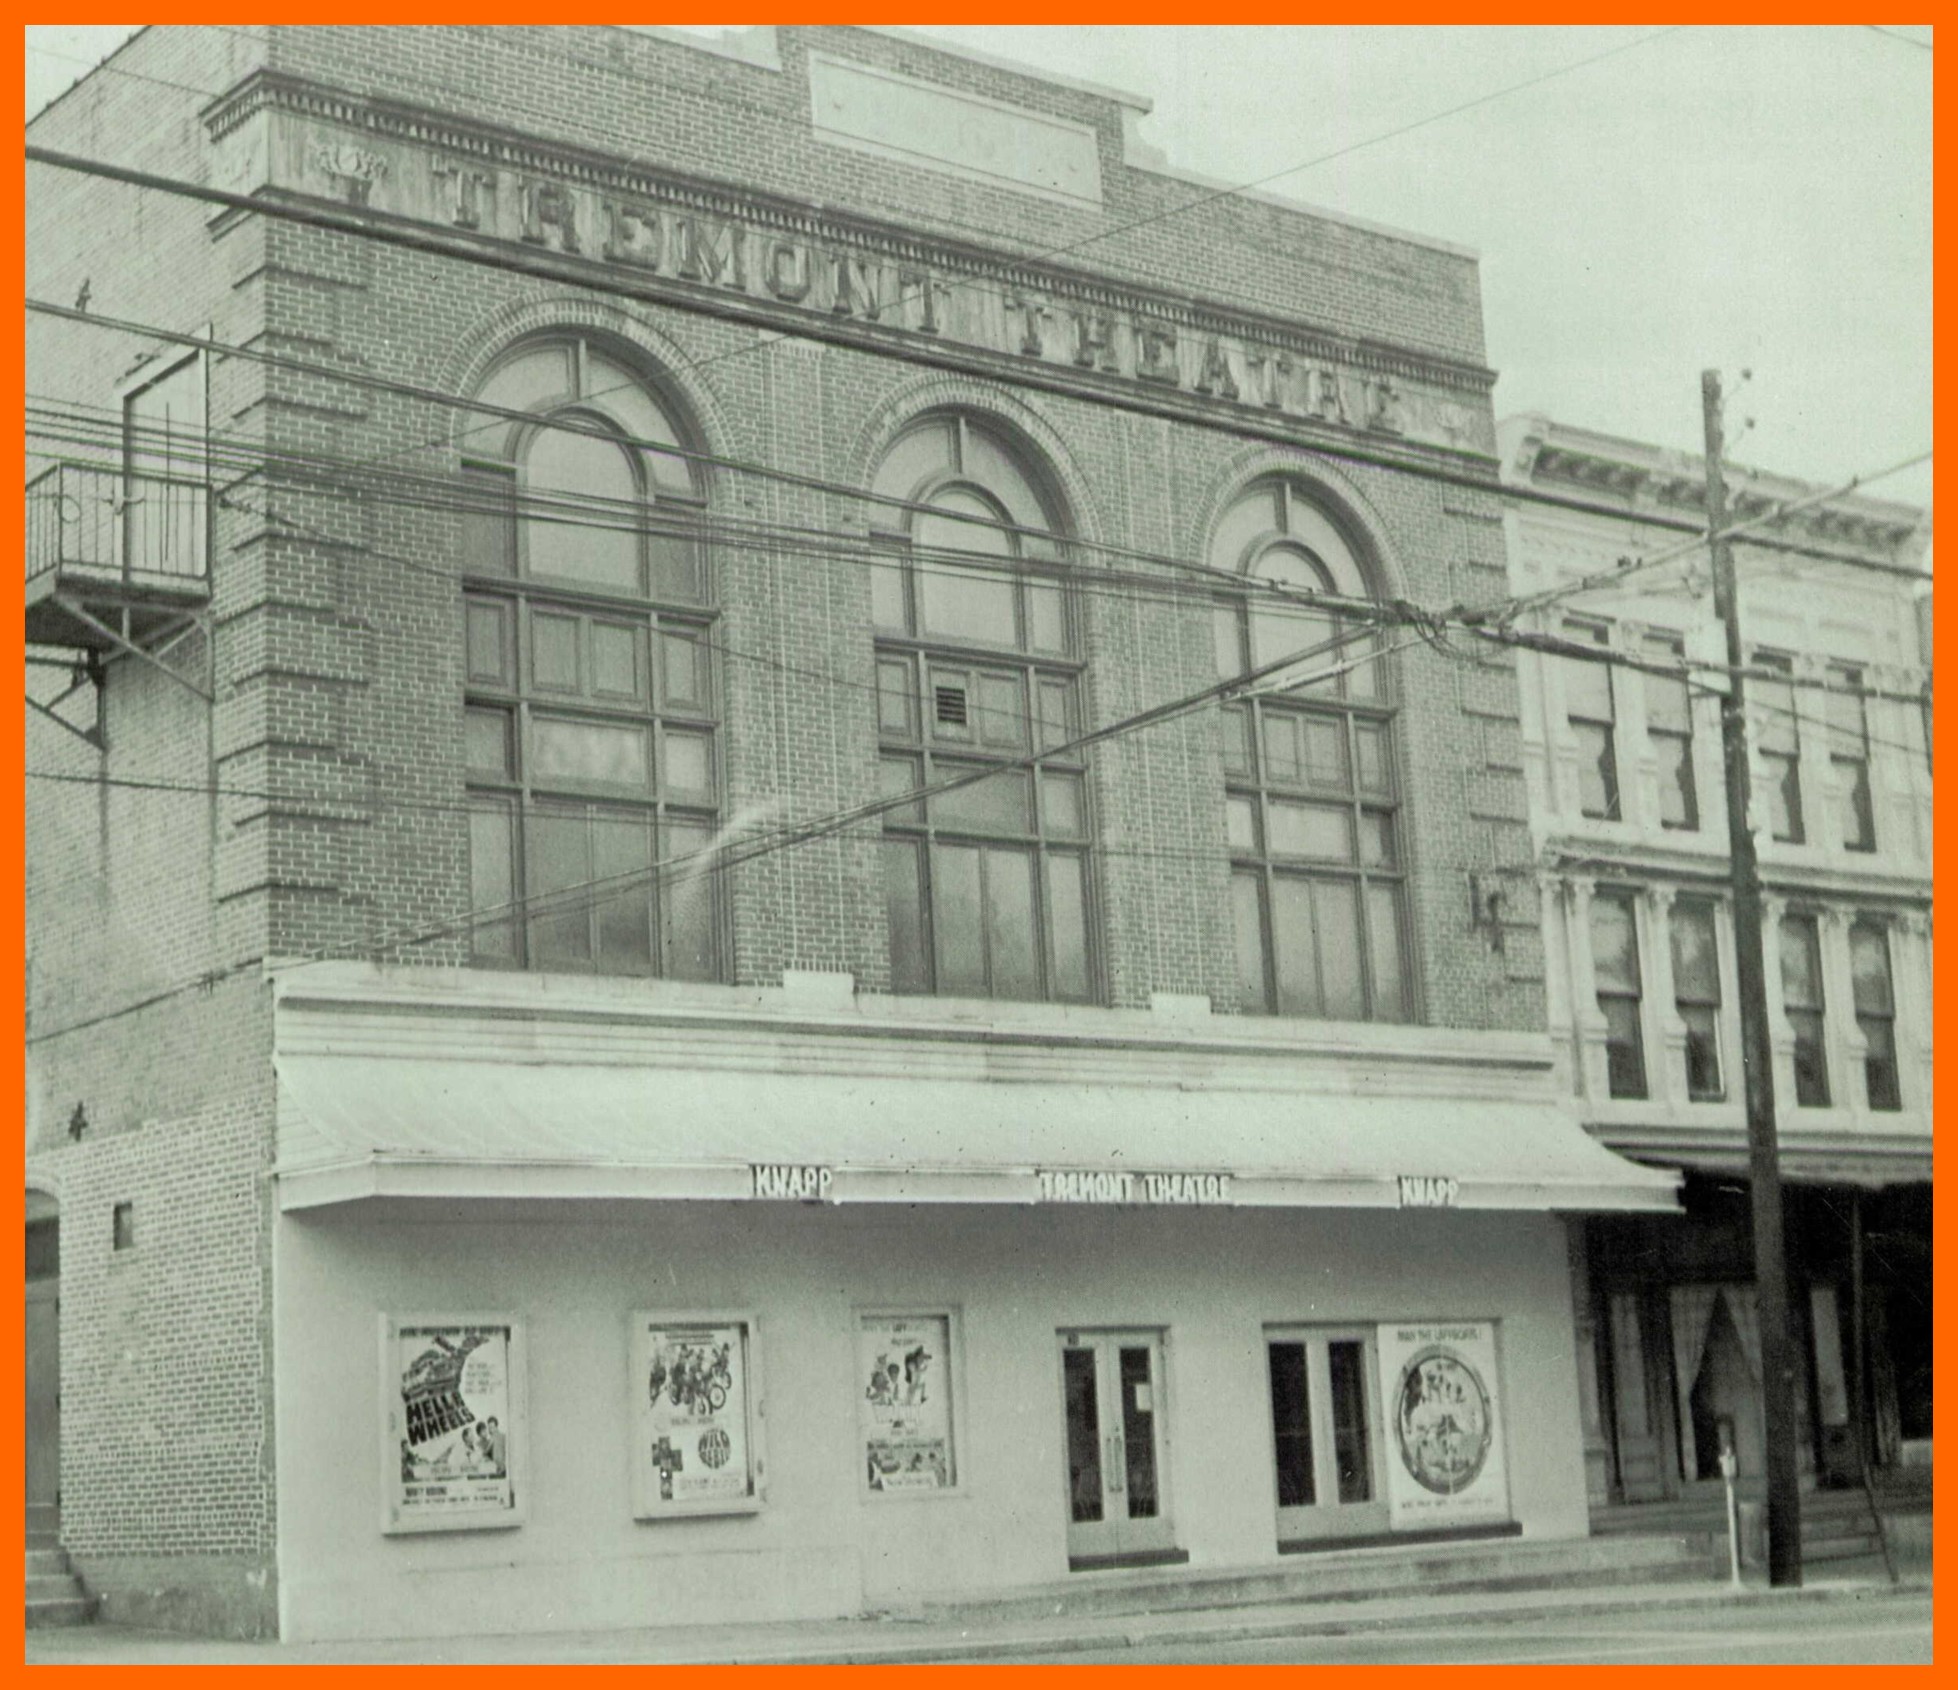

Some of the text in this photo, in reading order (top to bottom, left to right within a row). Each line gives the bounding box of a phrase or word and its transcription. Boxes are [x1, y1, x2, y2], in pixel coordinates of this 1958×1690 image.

[431, 153, 1402, 435] TREMONT THEATRE
[755, 1165, 832, 1198] KNAPP
[1039, 1172, 1230, 1203] TREMONT THEATRE
[1401, 1177, 1459, 1205] KNAPP
[407, 1408, 476, 1447] WHEELS
